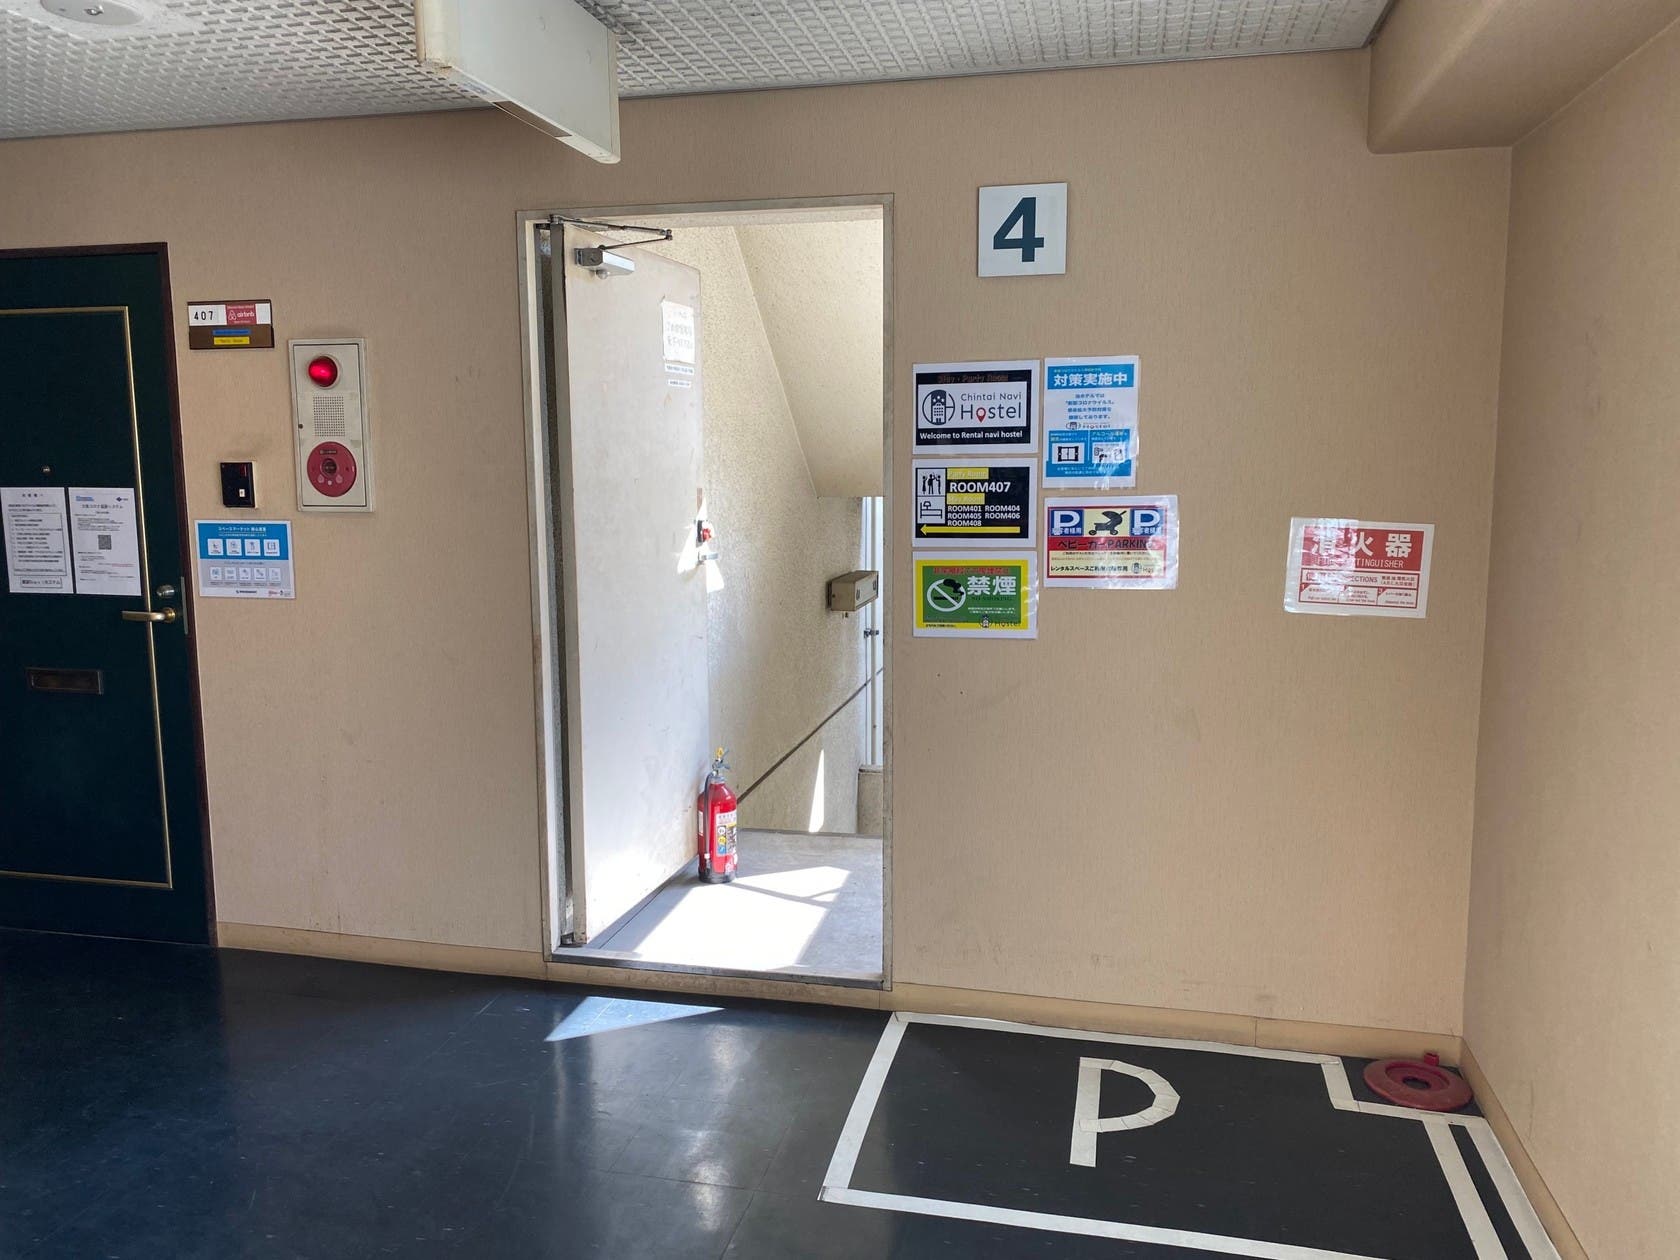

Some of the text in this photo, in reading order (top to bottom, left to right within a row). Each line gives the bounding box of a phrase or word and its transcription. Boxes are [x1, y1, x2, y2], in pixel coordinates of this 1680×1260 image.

[993, 196, 1045, 263] 4
[194, 310, 214, 321] 407
[1053, 371, 1128, 387] 対策実施中
[960, 391, 1022, 402] Chintai Navi
[960, 402, 1022, 423] Hostel
[919, 432, 952, 440] Welcome
[961, 431, 984, 439] Rental
[1000, 430, 1023, 438] hostel
[949, 481, 1011, 493] ROOM407
[967, 575, 1017, 596] 禁煙
[1069, 1056, 1181, 1168] P
